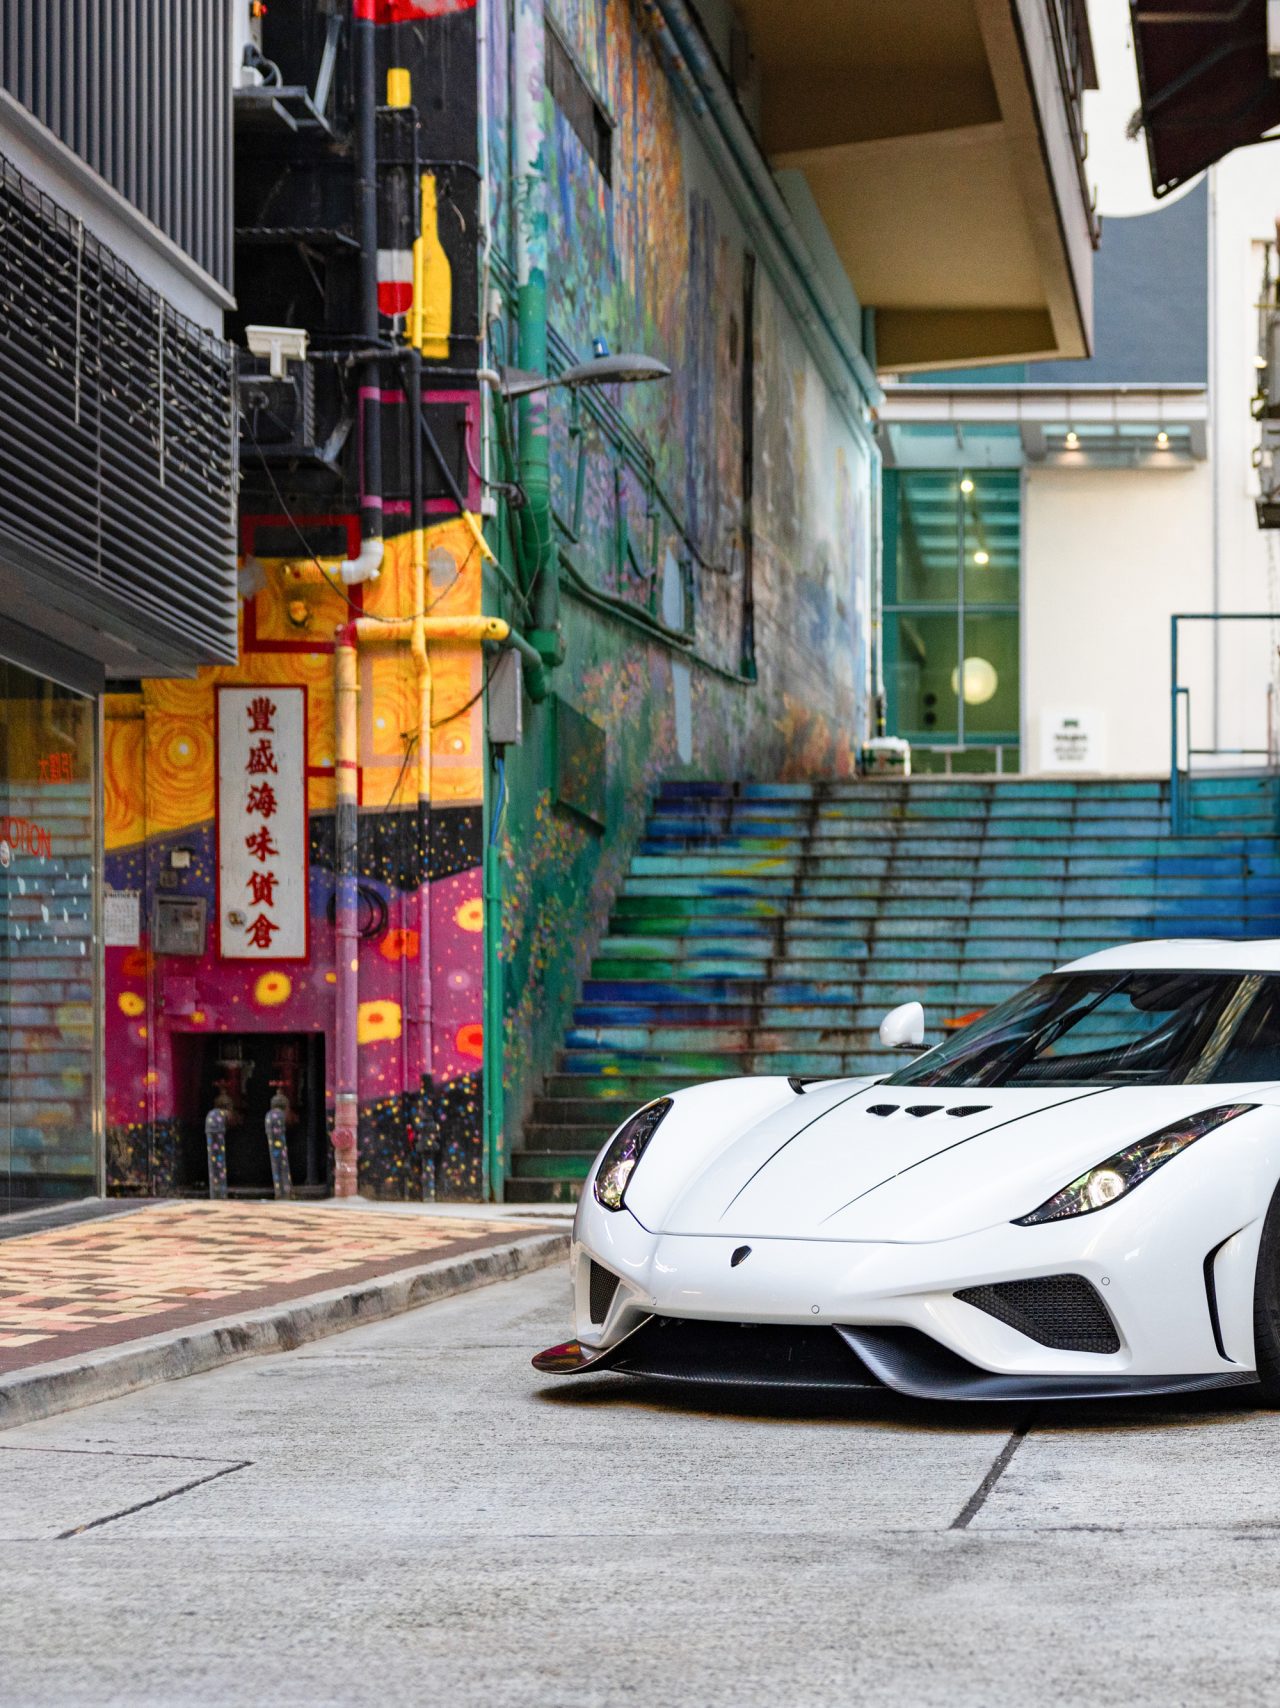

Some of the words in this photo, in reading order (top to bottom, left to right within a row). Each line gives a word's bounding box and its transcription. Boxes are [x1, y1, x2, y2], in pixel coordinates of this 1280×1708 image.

[245, 696, 279, 949] 豐盛海味貨倉
